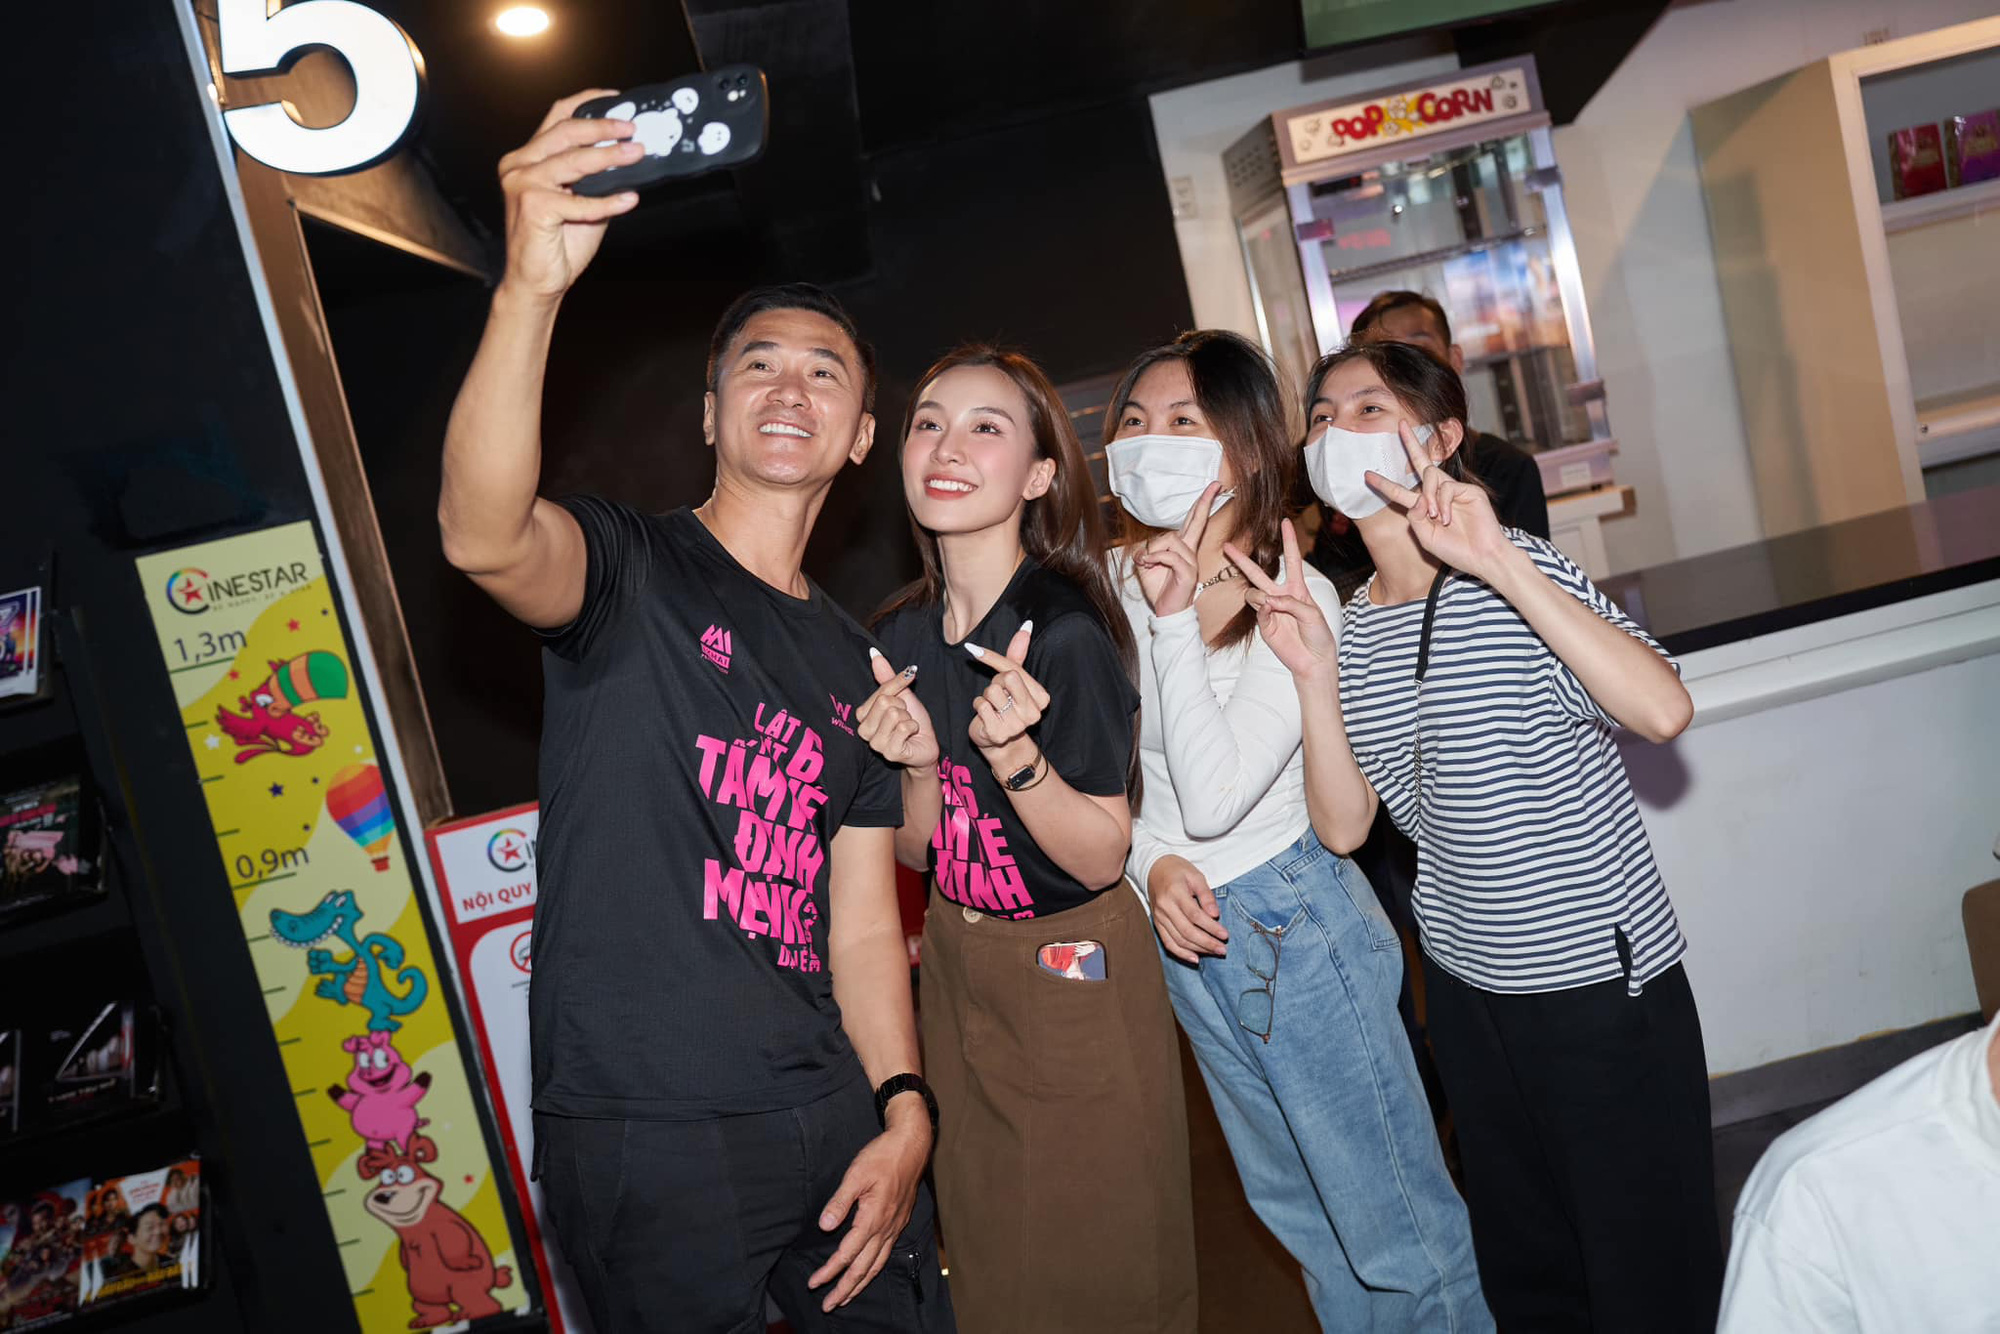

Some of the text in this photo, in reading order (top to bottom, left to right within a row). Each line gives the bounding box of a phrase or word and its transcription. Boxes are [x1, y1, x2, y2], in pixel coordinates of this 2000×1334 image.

[219, 0, 421, 175] 5
[1331, 88, 1494, 145] POP CORN
[174, 630, 247, 662] 1,3m
[236, 846, 309, 879] 0,9m
[498, 882, 532, 905] QUY
